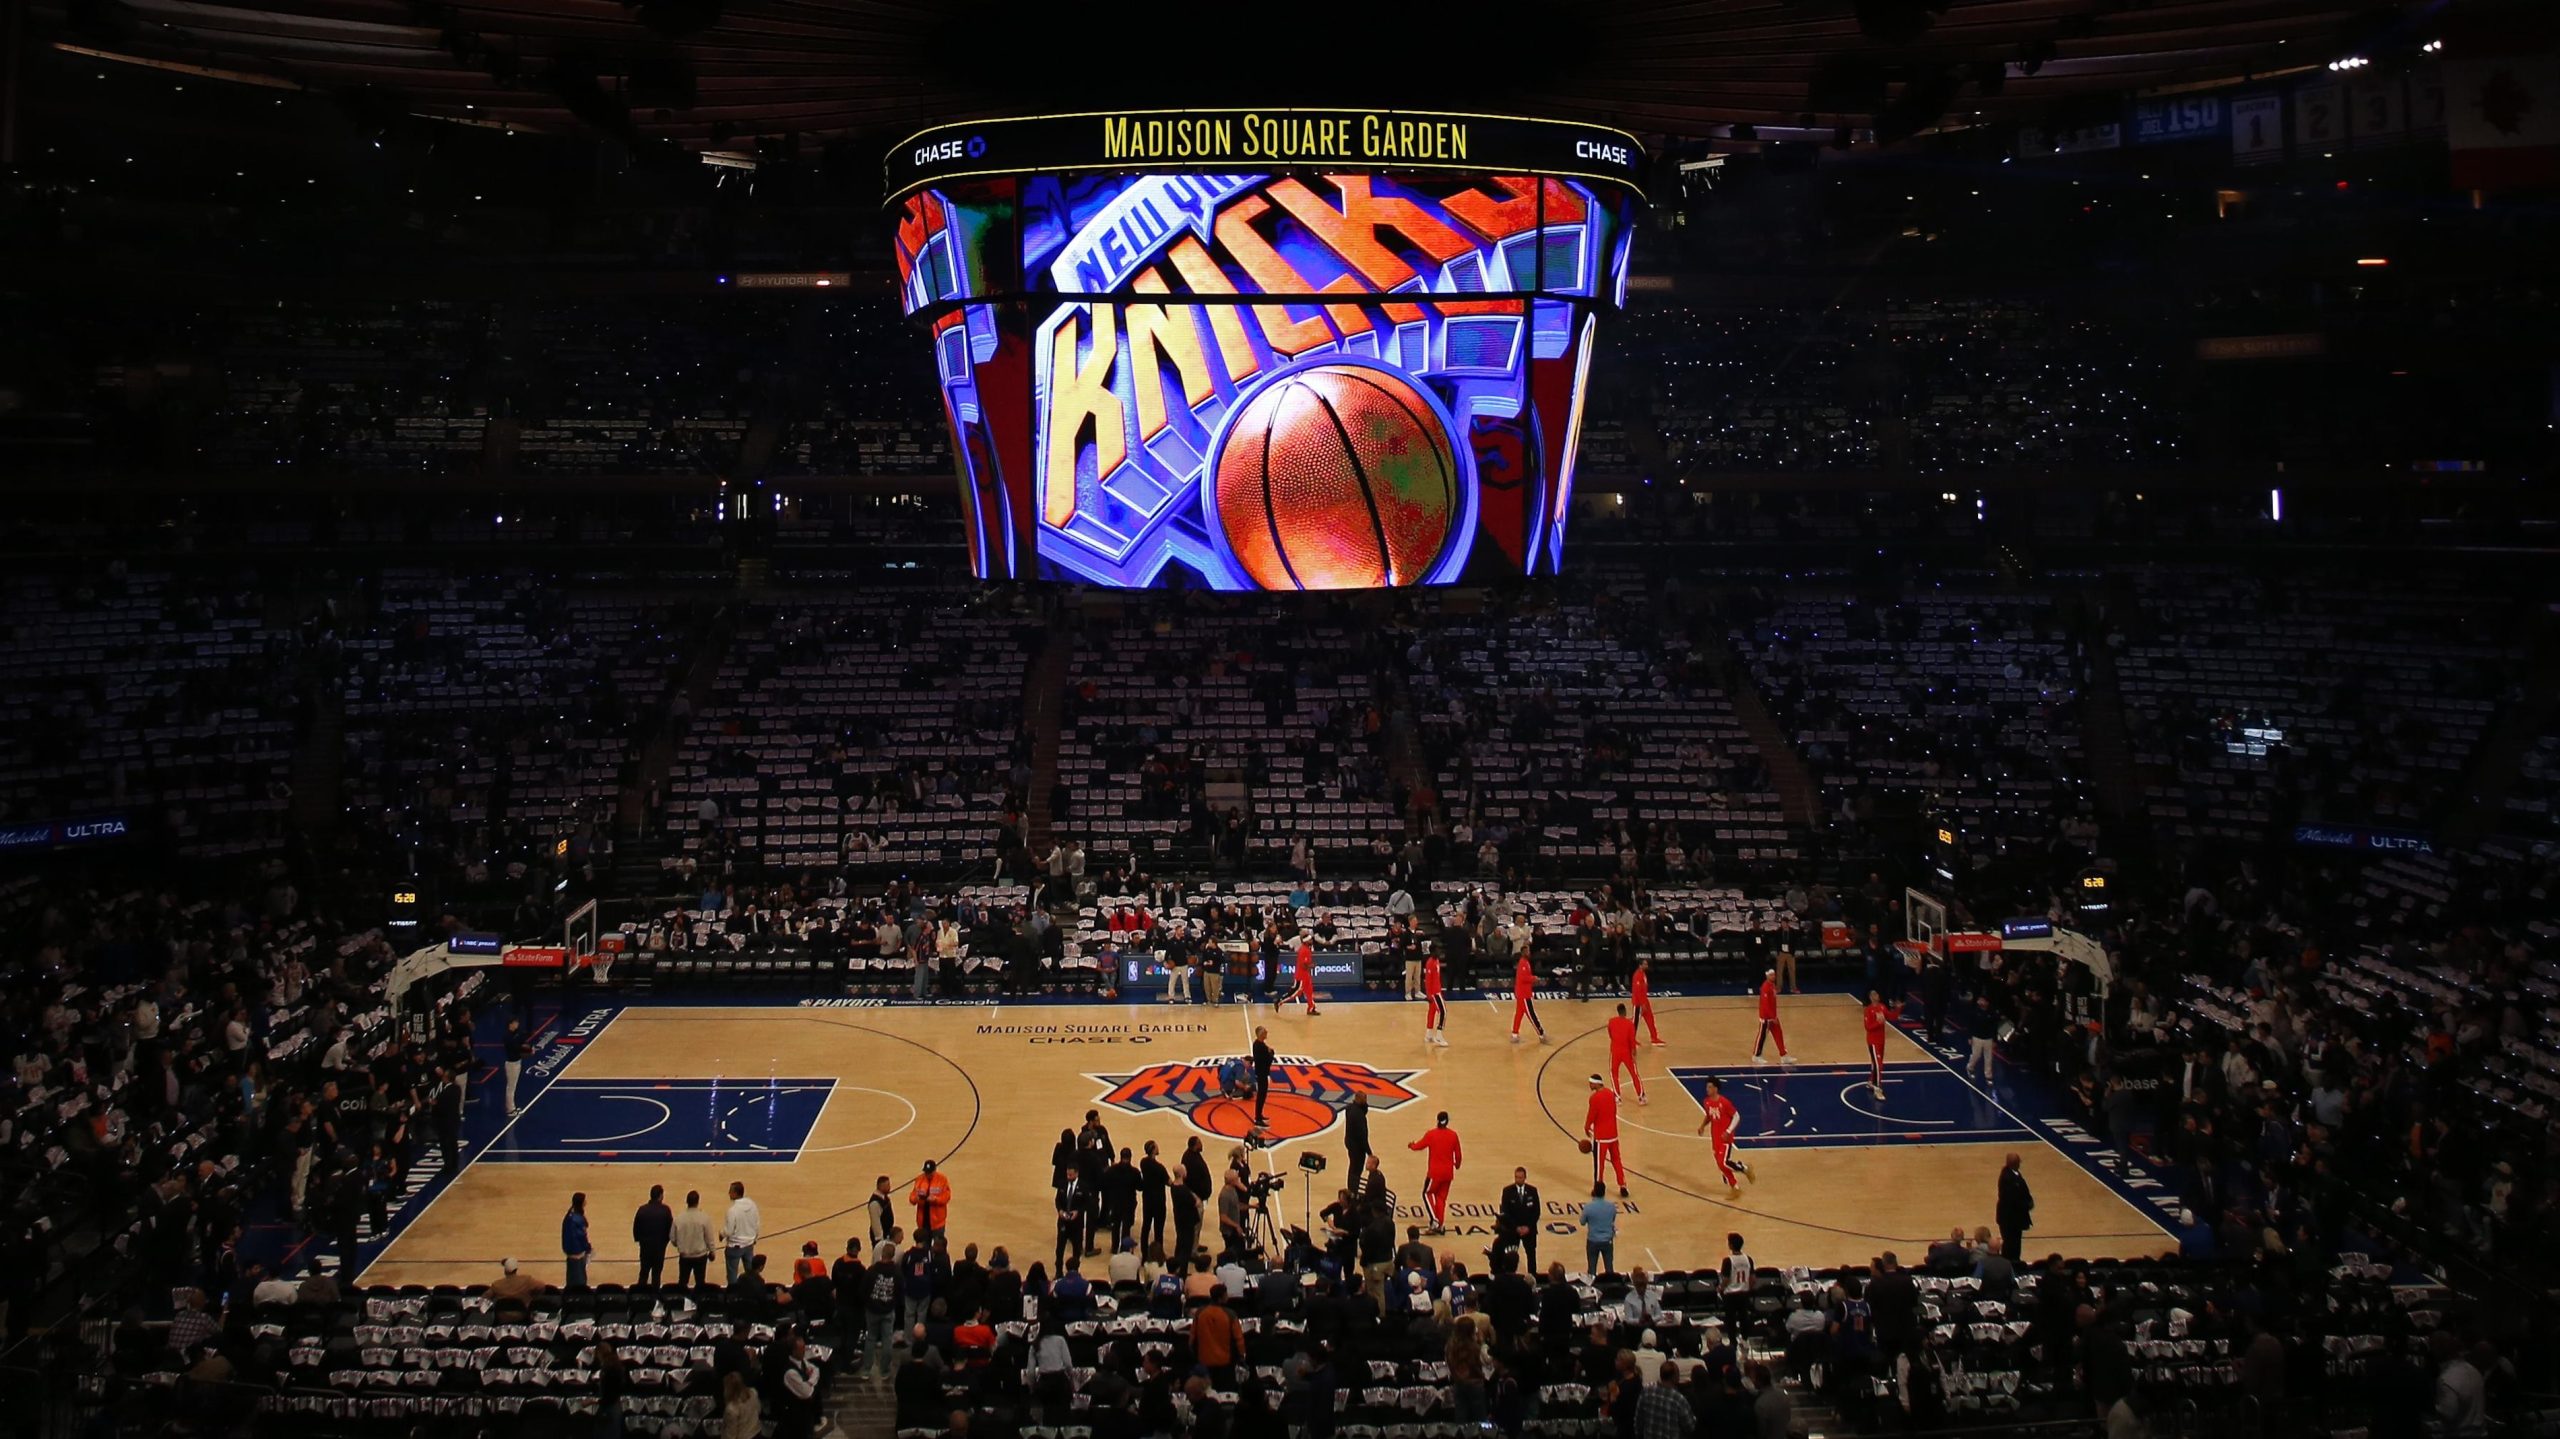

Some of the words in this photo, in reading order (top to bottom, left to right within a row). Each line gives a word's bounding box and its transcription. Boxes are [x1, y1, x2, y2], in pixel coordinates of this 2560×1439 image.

[2168, 97, 2219, 132] 150
[1103, 117, 1232, 159] MADISON
[1242, 113, 1352, 159] SQUARE
[1362, 114, 1467, 159] GARDEN
[2249, 114, 2264, 148] 1
[914, 140, 964, 166] CHASE
[1575, 140, 1628, 165] CHASE
[67, 821, 126, 838] ULTRA
[2370, 835, 2433, 853] ULTRA
[1314, 962, 1352, 974] peacock
[567, 1007, 614, 1037] ULTRA
[976, 1025, 1057, 1034] MADISON
[1064, 1024, 1131, 1034] SQUARE
[1139, 1024, 1208, 1033] GARDEN
[1029, 1036, 1123, 1044] CHASE
